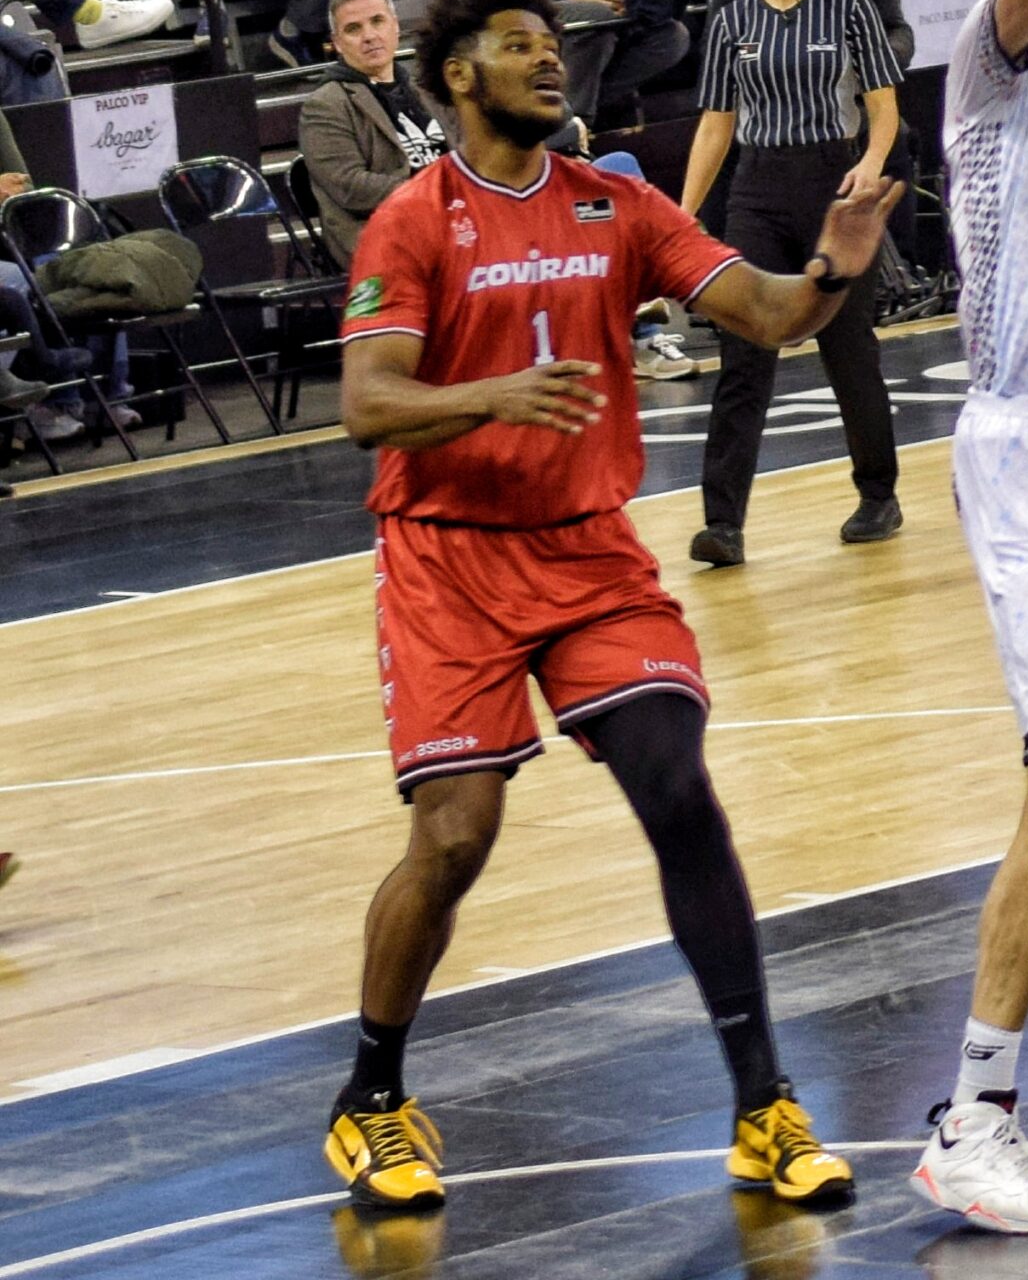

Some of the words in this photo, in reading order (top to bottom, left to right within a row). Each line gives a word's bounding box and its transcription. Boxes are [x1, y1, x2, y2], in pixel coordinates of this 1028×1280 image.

[96, 96, 130, 112] PALCO
[130, 93, 149, 107] VIP
[532, 310, 555, 366] 1
